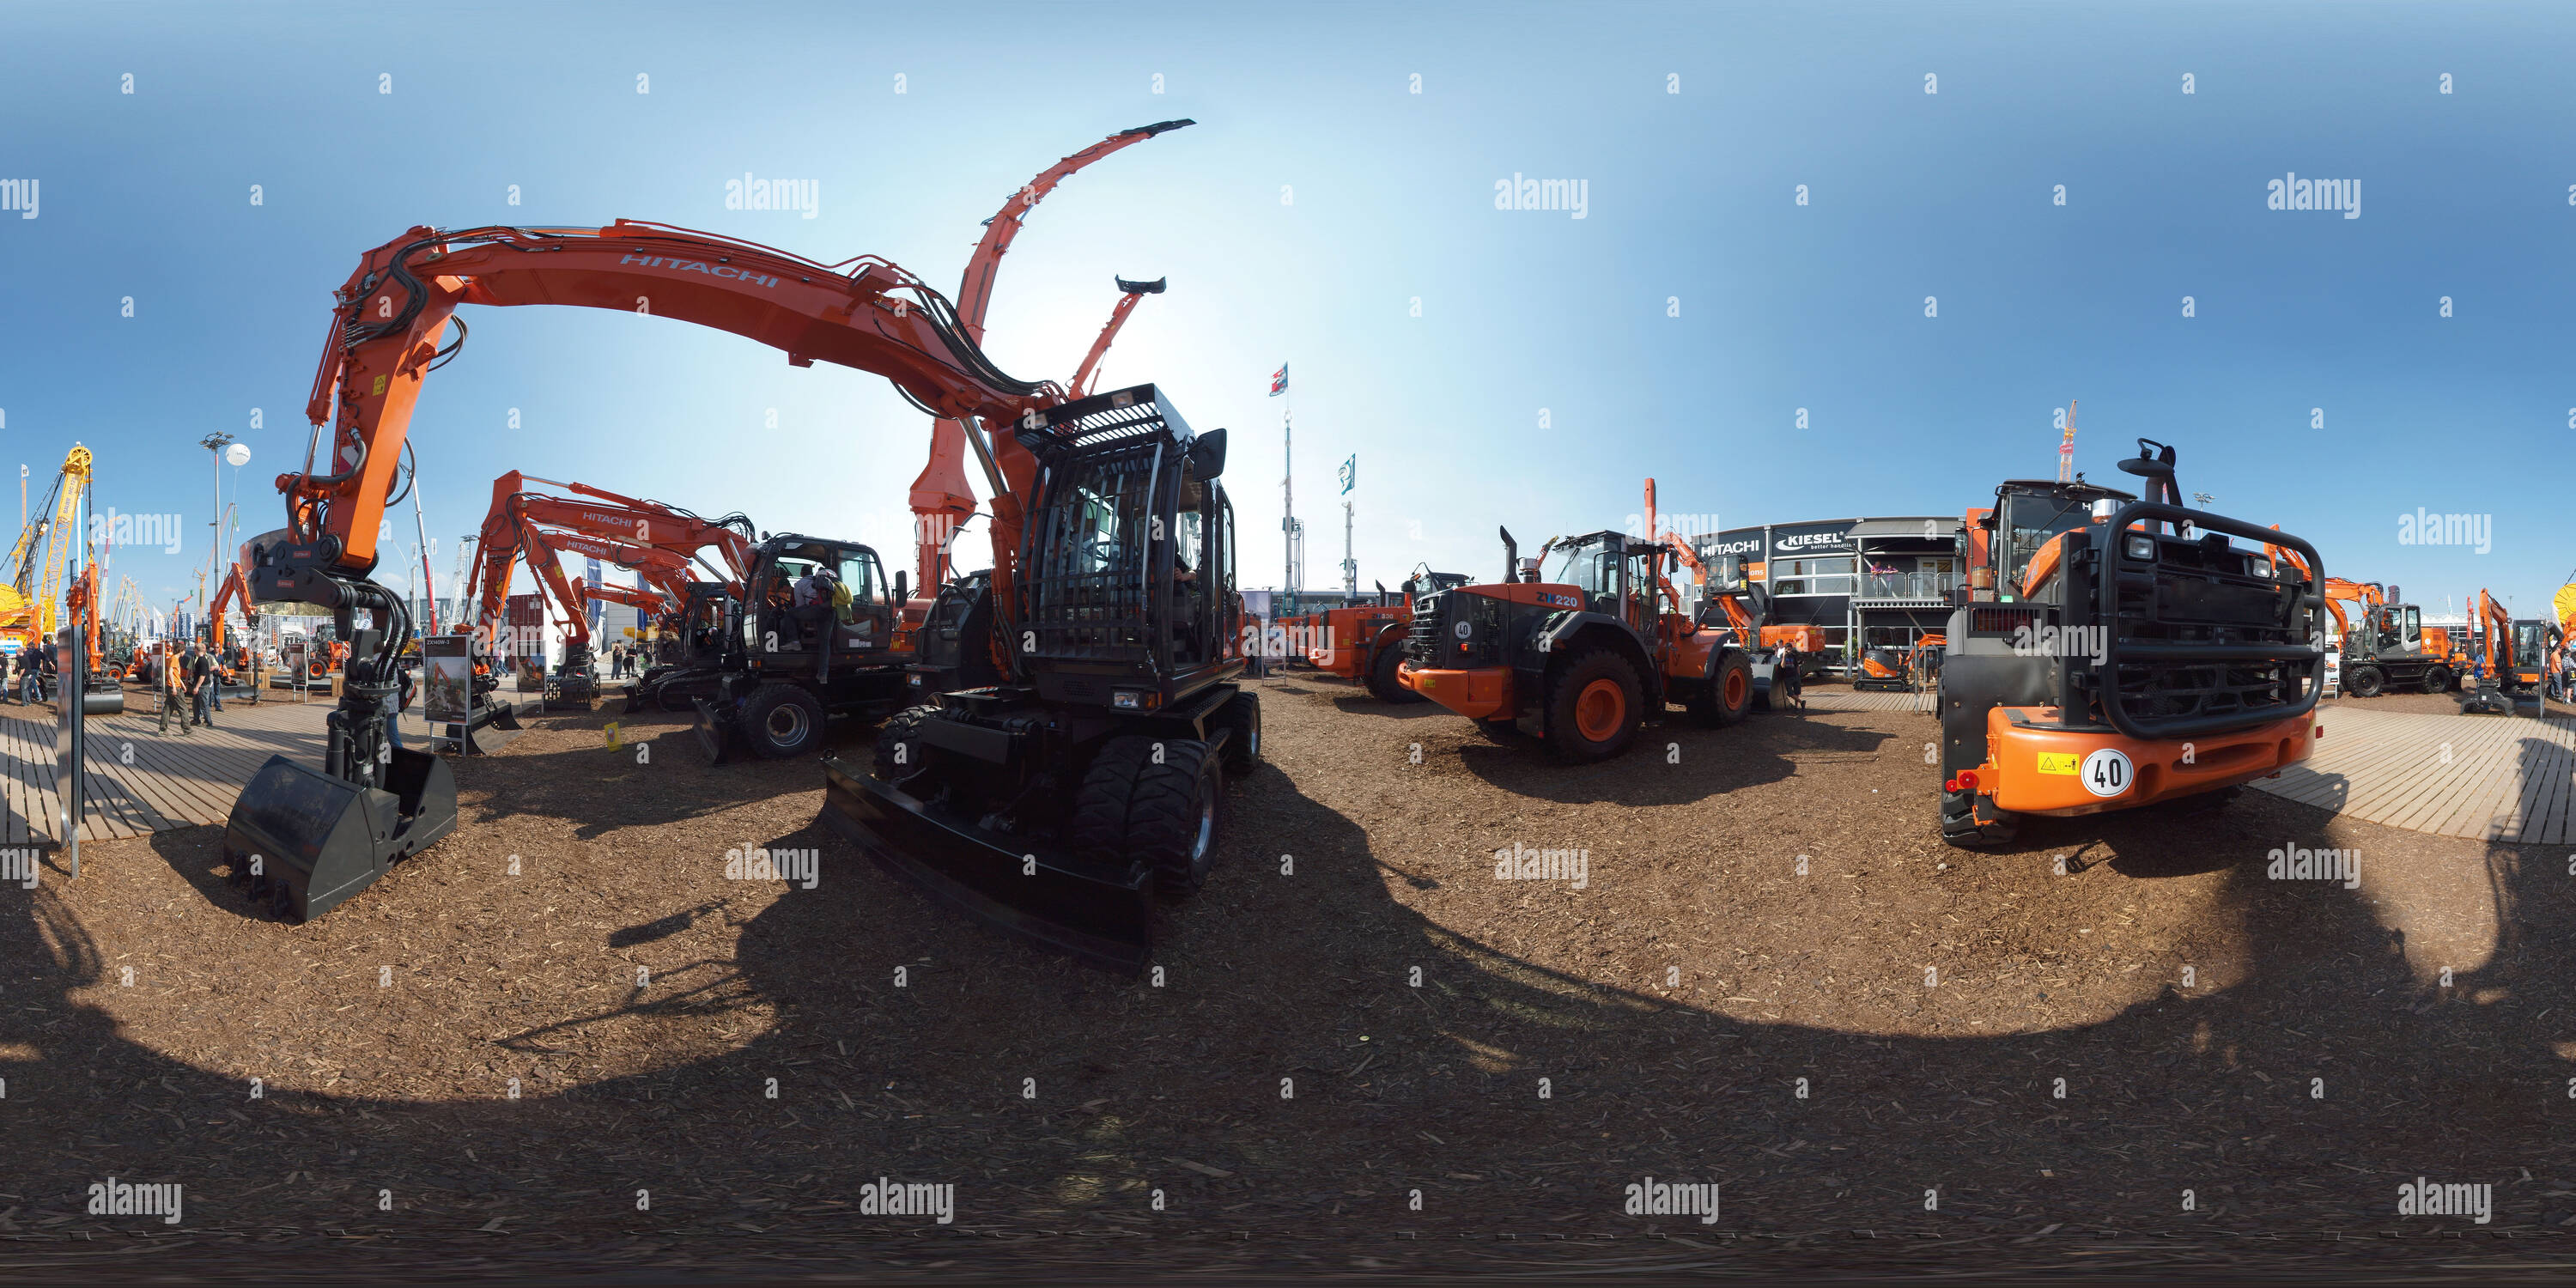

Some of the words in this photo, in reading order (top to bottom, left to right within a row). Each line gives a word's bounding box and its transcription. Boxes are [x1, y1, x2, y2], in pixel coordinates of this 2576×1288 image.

[620, 253, 779, 288] HITACHI
[583, 511, 632, 528] HITACHI
[567, 540, 607, 556] HITACHI
[1701, 539, 1759, 557] HITACHI
[1536, 591, 1578, 608] ZW220
[1458, 625, 1469, 636] 40
[2093, 758, 2123, 787] 40
